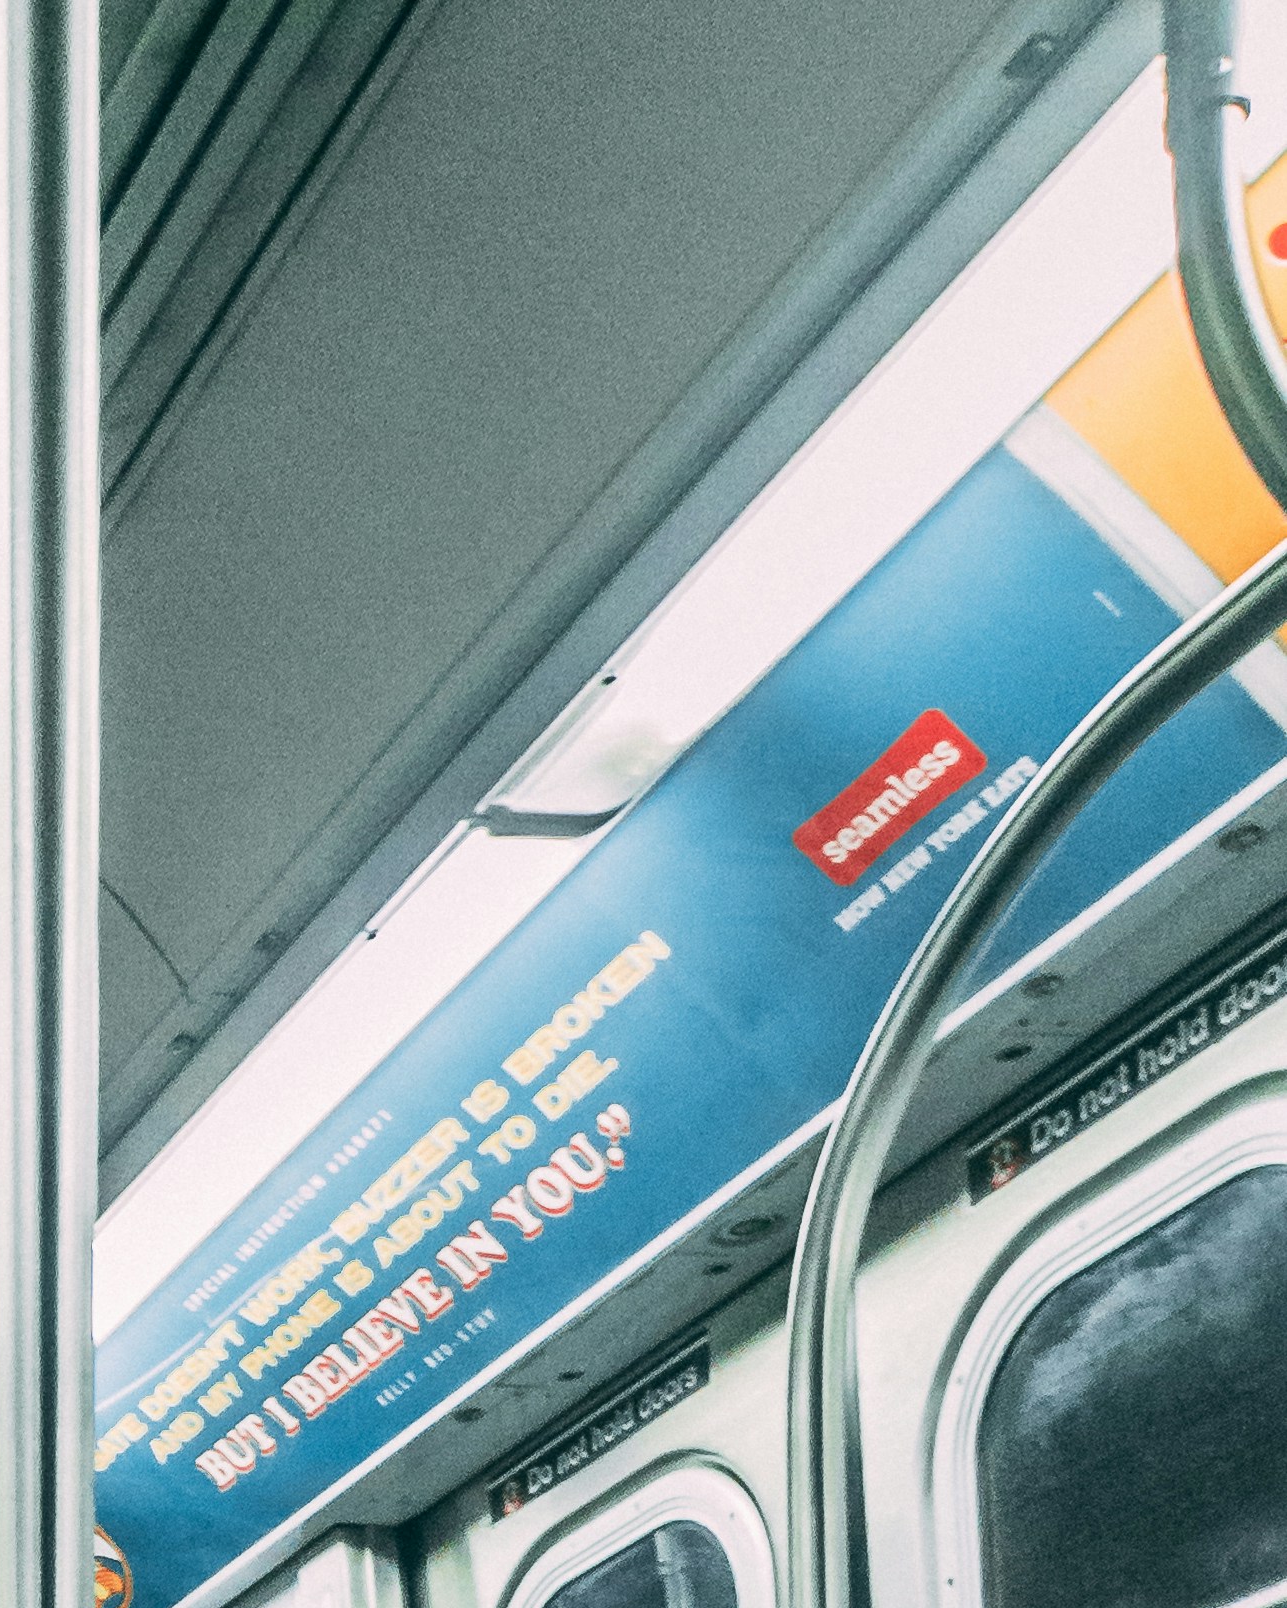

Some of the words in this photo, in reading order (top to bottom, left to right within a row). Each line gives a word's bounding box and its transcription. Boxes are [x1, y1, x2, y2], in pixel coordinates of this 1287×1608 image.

[820, 738, 962, 865] seamless
[239, 1240, 343, 1328] WORK,
[331, 1117, 469, 1246] BUZZER
[462, 1079, 509, 1124] IS
[502, 930, 671, 1086] BROKEN
[1030, 1109, 1073, 1154] Do
[1080, 1062, 1130, 1122] not
[1138, 1004, 1210, 1082] hold
[1218, 955, 1287, 1026] doo
[150, 1407, 205, 1465] AND
[198, 1371, 244, 1418] MY
[239, 1288, 342, 1381] PHONE
[333, 1259, 374, 1298] IS
[373, 1158, 482, 1273] ABOUT
[476, 1113, 536, 1165] TO
[195, 1411, 275, 1492] BUT
[263, 1395, 300, 1437] I
[282, 1267, 454, 1421] BELIEVE
[437, 1220, 509, 1291] IN
